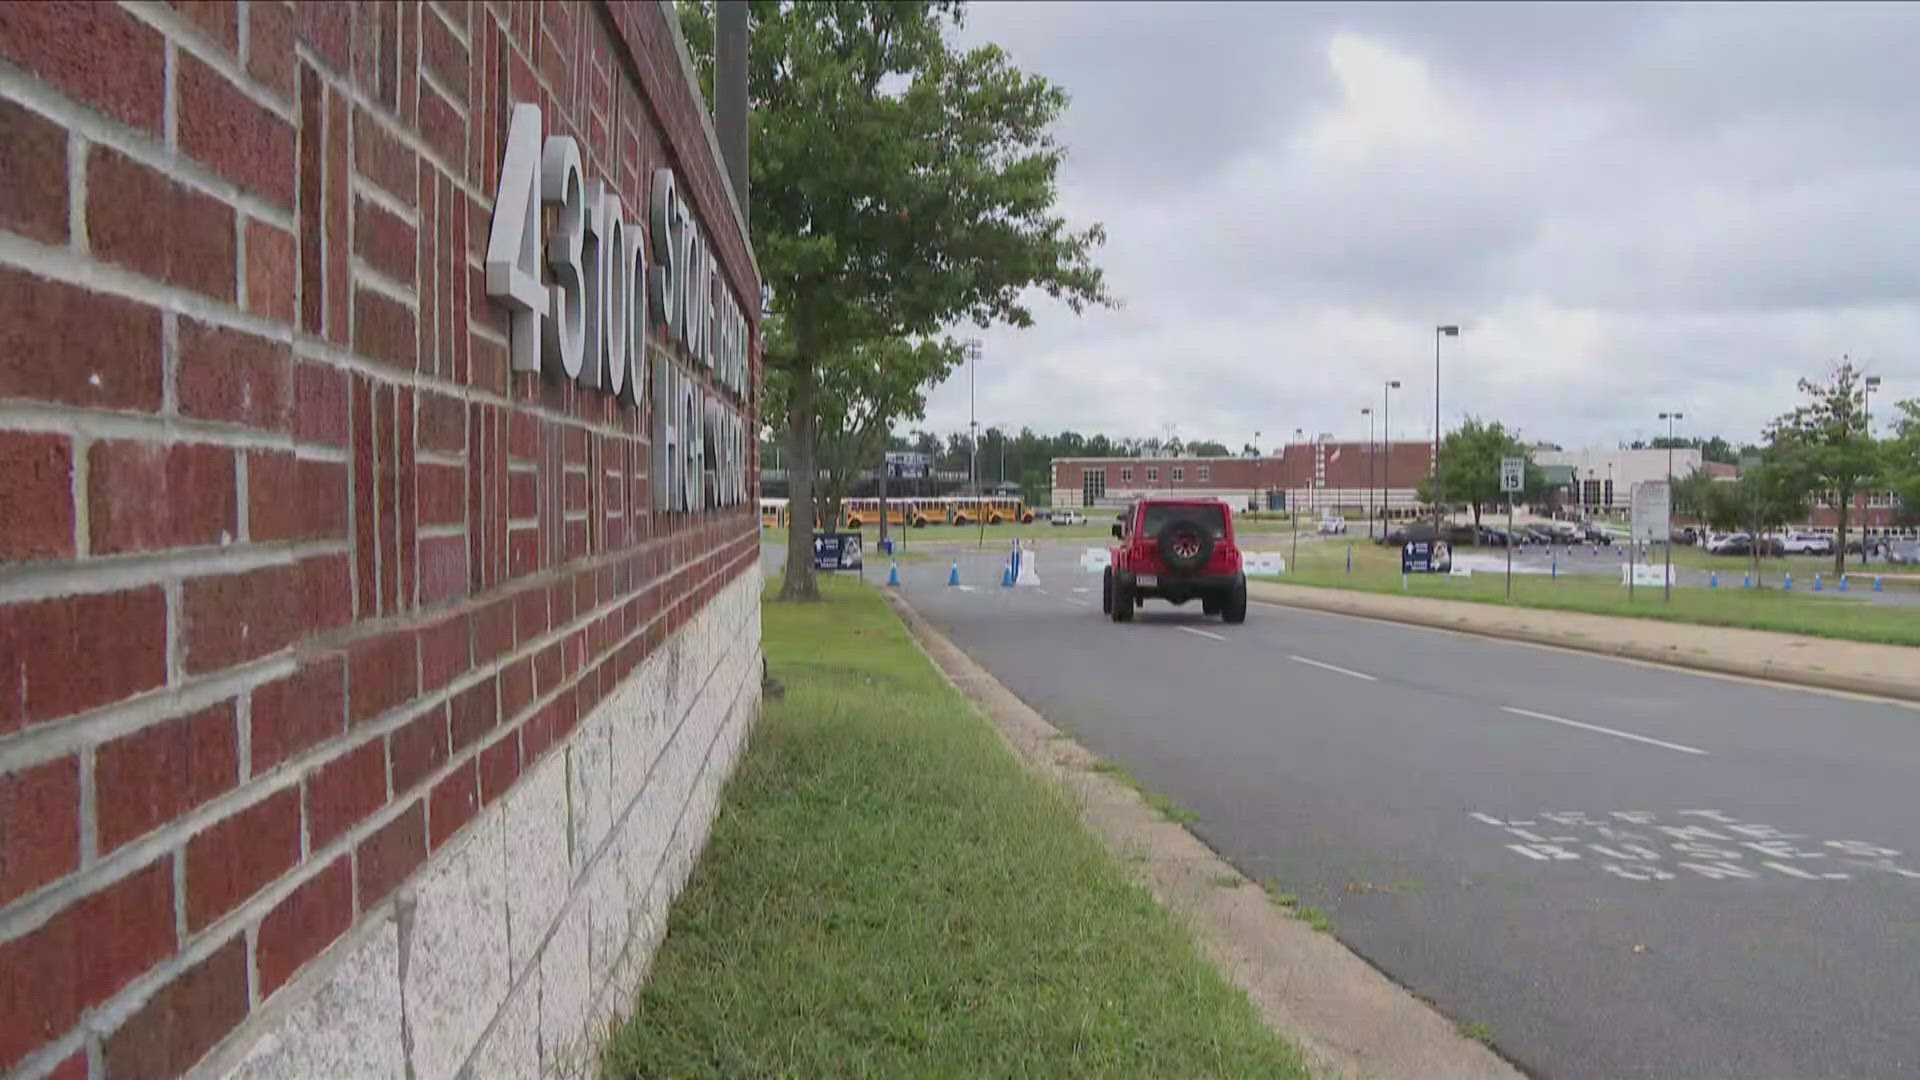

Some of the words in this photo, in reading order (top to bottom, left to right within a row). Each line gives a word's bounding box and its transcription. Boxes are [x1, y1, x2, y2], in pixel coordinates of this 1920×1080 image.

[486, 103, 646, 406] 43100
[650, 168, 717, 368] STONE
[716, 280, 750, 396] BRIDGE
[652, 357, 705, 512] HIGH
[705, 397, 747, 509] SCHOOL
[1505, 475, 1519, 488] 15
[1468, 809, 1740, 827] LEFT
[1503, 824, 1808, 842] LANE
[1504, 840, 1903, 860] BUSES
